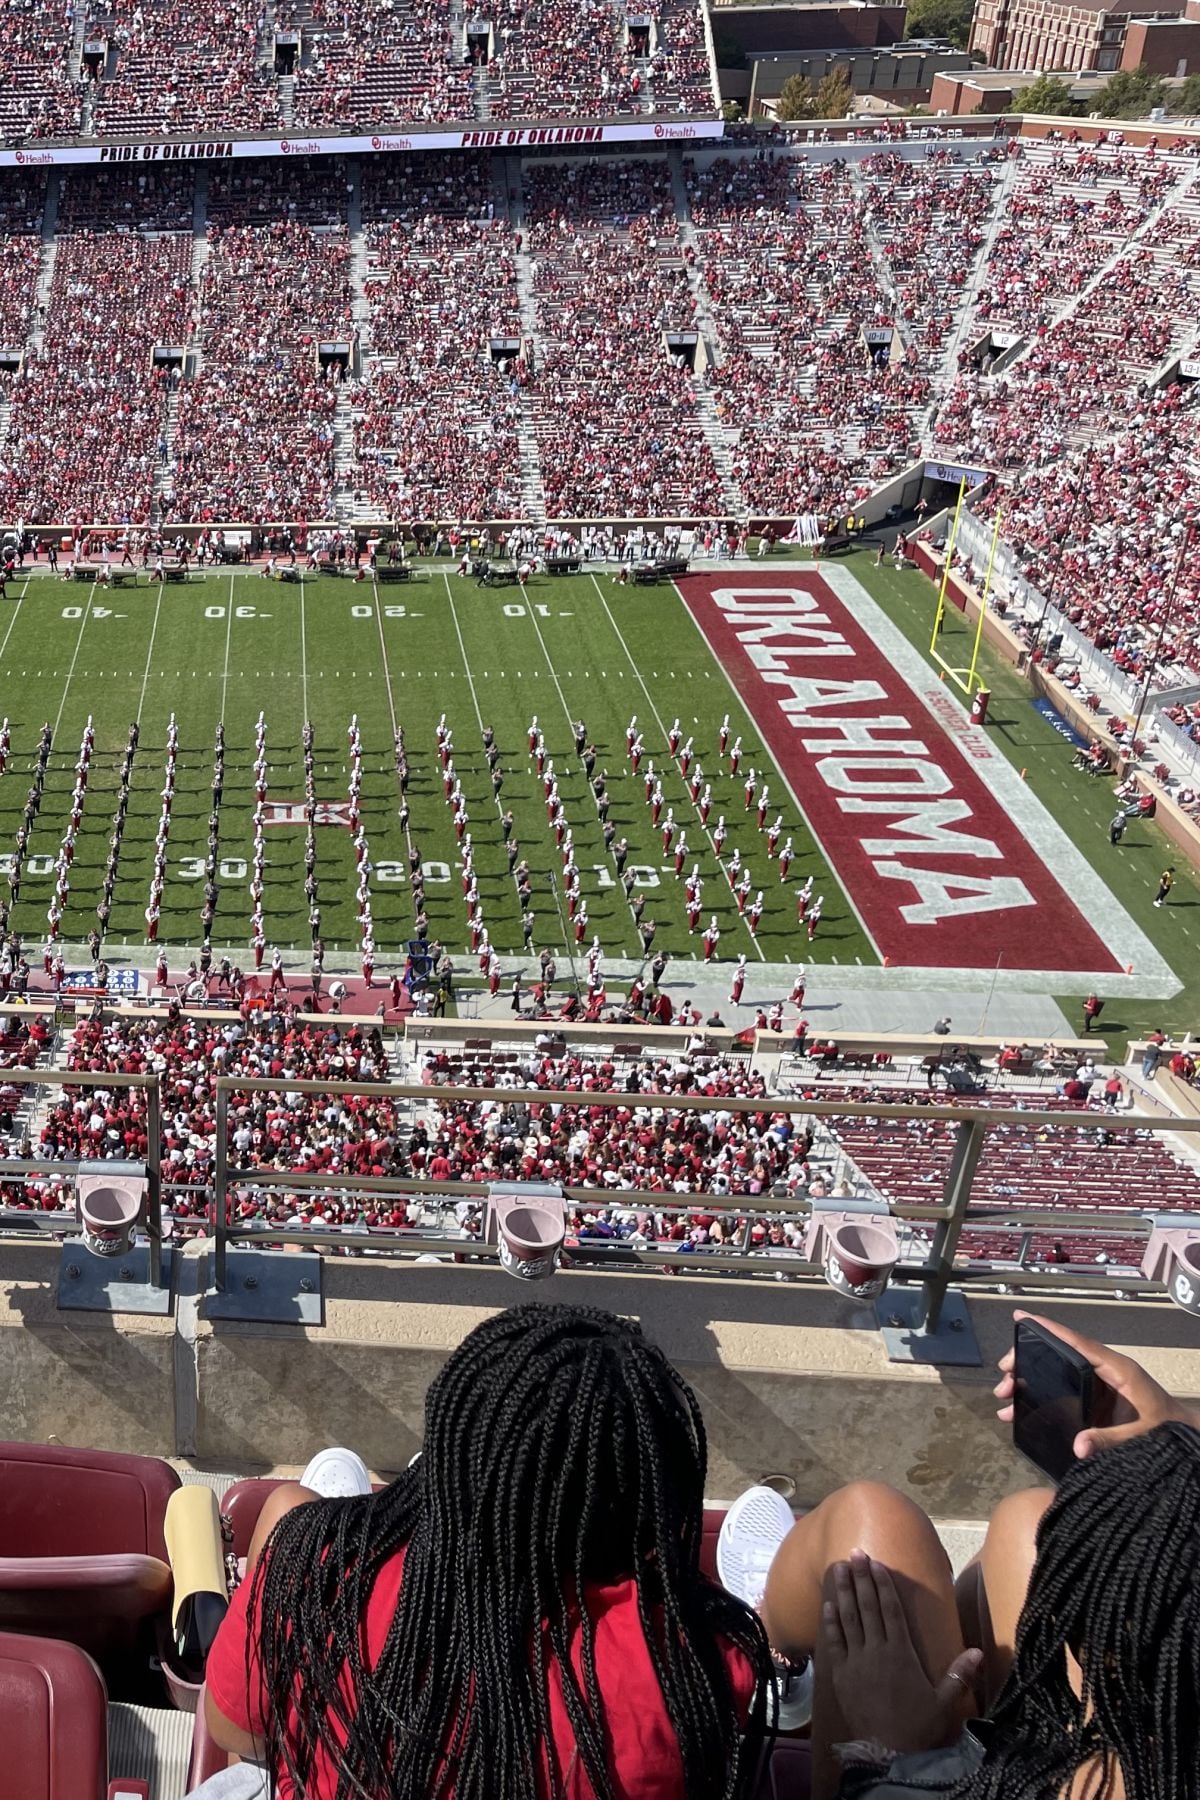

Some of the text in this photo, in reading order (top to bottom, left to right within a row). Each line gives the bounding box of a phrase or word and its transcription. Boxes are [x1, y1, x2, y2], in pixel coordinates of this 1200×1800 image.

[461, 127, 604, 146] PRIDE OF OKLAHOMA
[654, 124, 696, 138] OU Health
[280, 140, 320, 154] OU Health
[372, 136, 412, 150] OU Health
[16, 152, 54, 164] OU Health
[100, 142, 233, 162] PRIDE OF OKLAHOMA
[868, 332, 885, 340] 10-11
[1000, 336, 1009, 344] 12
[61, 606, 112, 618] 40
[204, 605, 256, 618] 30
[350, 604, 406, 617] 20
[503, 604, 554, 617] 10
[958, 734, 993, 760] CLUB
[709, 587, 1037, 925] OKLAHOMA
[178, 856, 248, 880] 30
[376, 860, 451, 884] 20
[593, 864, 661, 888] 10
[500, 1238, 512, 1266] OU
[829, 1256, 845, 1284] OU
[1175, 1274, 1194, 1304] OU
